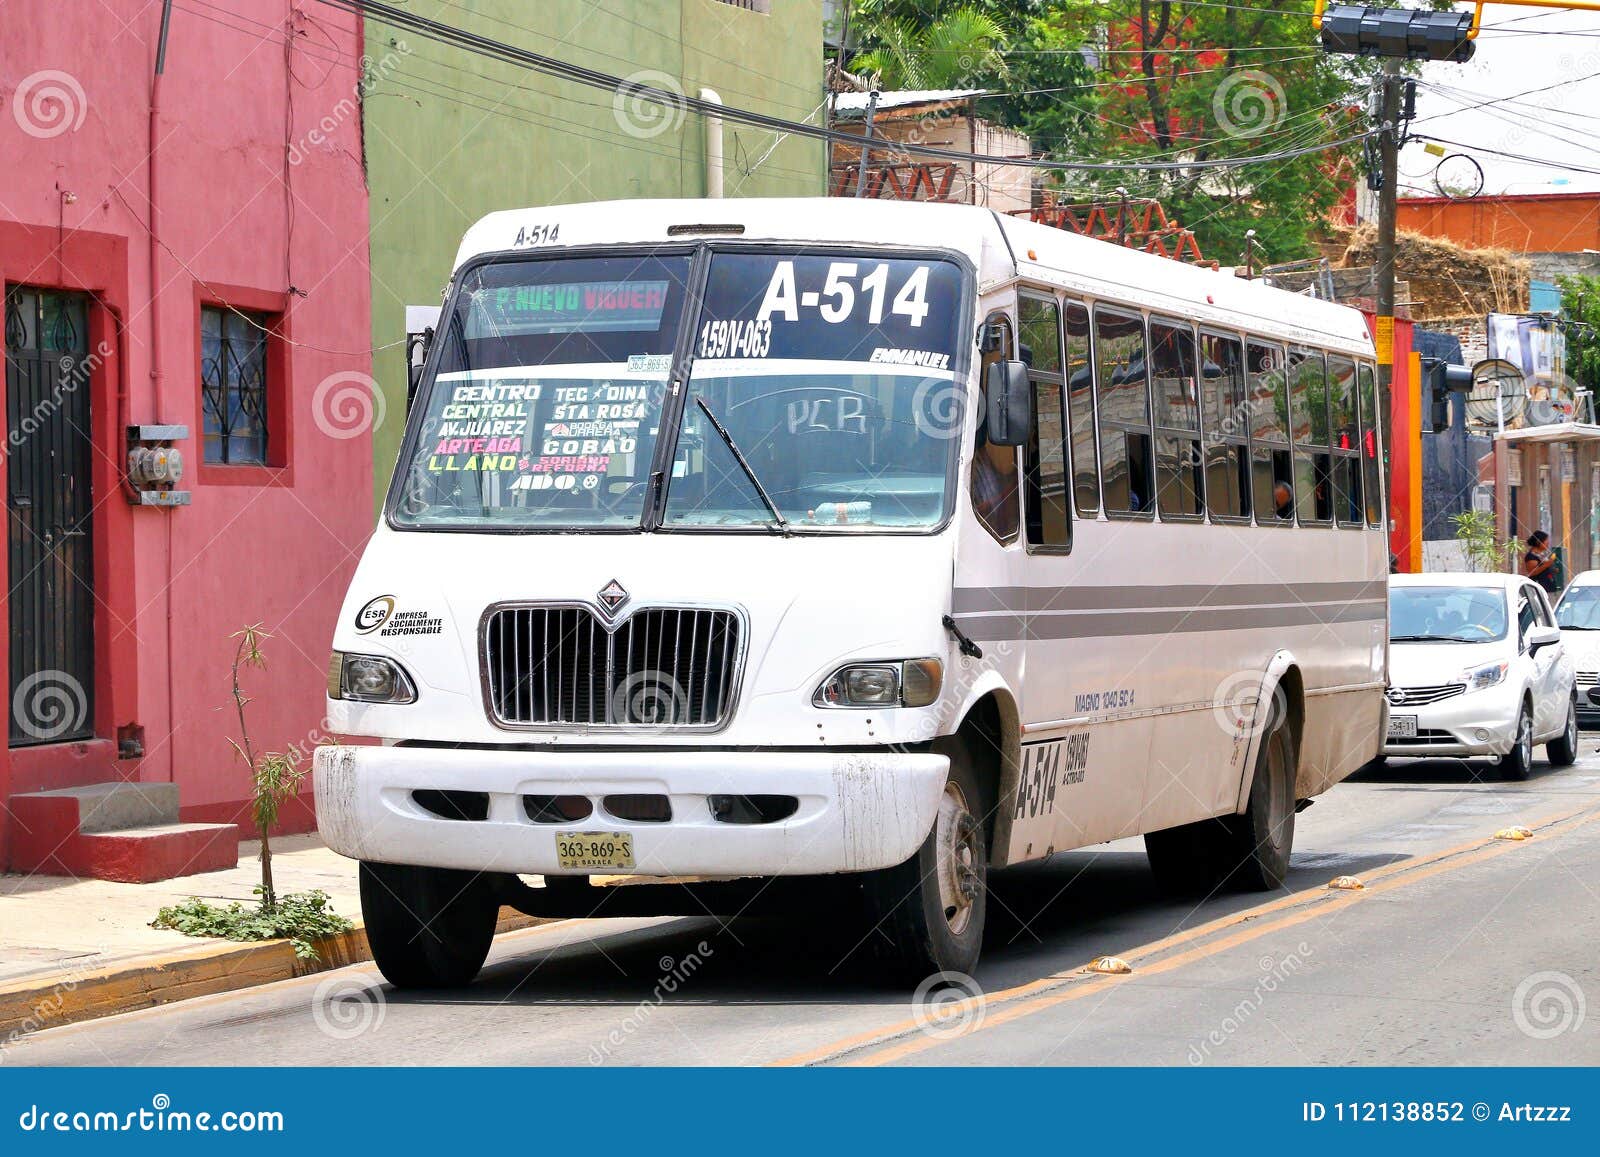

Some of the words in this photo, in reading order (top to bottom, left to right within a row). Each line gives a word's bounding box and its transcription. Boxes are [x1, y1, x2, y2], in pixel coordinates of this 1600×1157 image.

[513, 223, 560, 246] A-514
[755, 260, 930, 327] A-514
[701, 319, 772, 358] 159/V-063
[869, 347, 950, 370] EMMANUEL
[453, 384, 542, 401] CENTRO
[555, 387, 588, 402] TEC
[606, 385, 647, 400] DINA
[441, 403, 528, 419] CENTRAL
[596, 403, 646, 418] ROSA
[438, 420, 527, 437] AV.JUAREZ
[434, 438, 522, 454] ARTEAGA
[543, 438, 636, 455] COBAO
[428, 455, 517, 471] LLANO
[364, 609, 386, 619] ESR
[394, 611, 428, 620] EMPRESA
[380, 626, 442, 637] RESPONSABLE
[388, 618, 443, 628] SOCIALMENTE
[1129, 688, 1135, 706] 4
[1014, 743, 1061, 820] A-514
[559, 842, 631, 857] 363-869-S
